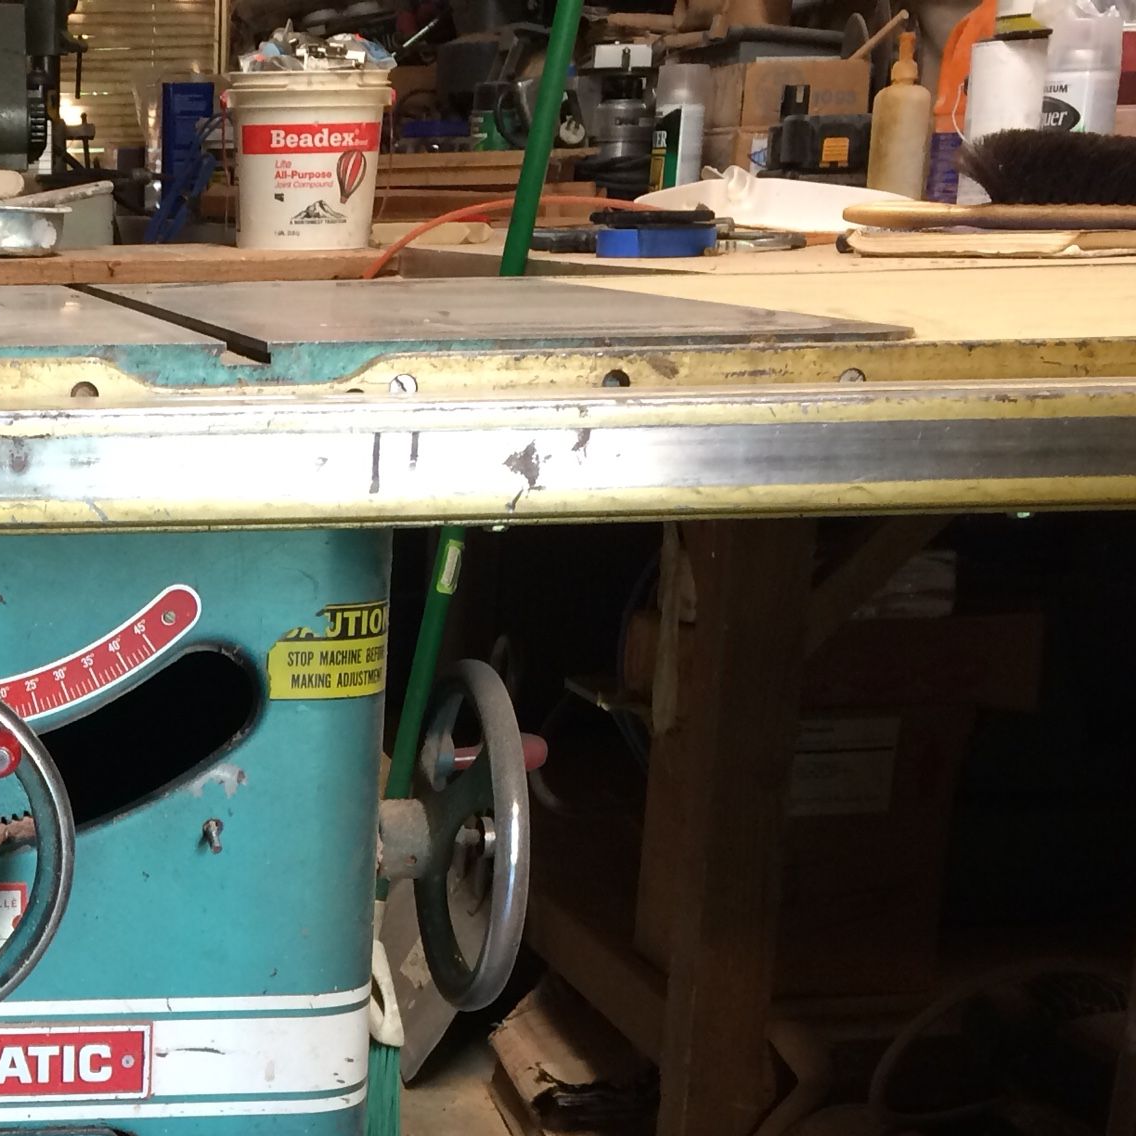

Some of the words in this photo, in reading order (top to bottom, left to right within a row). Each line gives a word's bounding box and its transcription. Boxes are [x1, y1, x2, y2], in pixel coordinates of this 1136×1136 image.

[270, 128, 355, 148] Beadex
[274, 170, 332, 180] All-Purpose
[293, 181, 334, 189] Compound
[287, 651, 314, 667] STOP
[319, 649, 362, 666] MACHINE
[291, 673, 331, 689] MAKING
